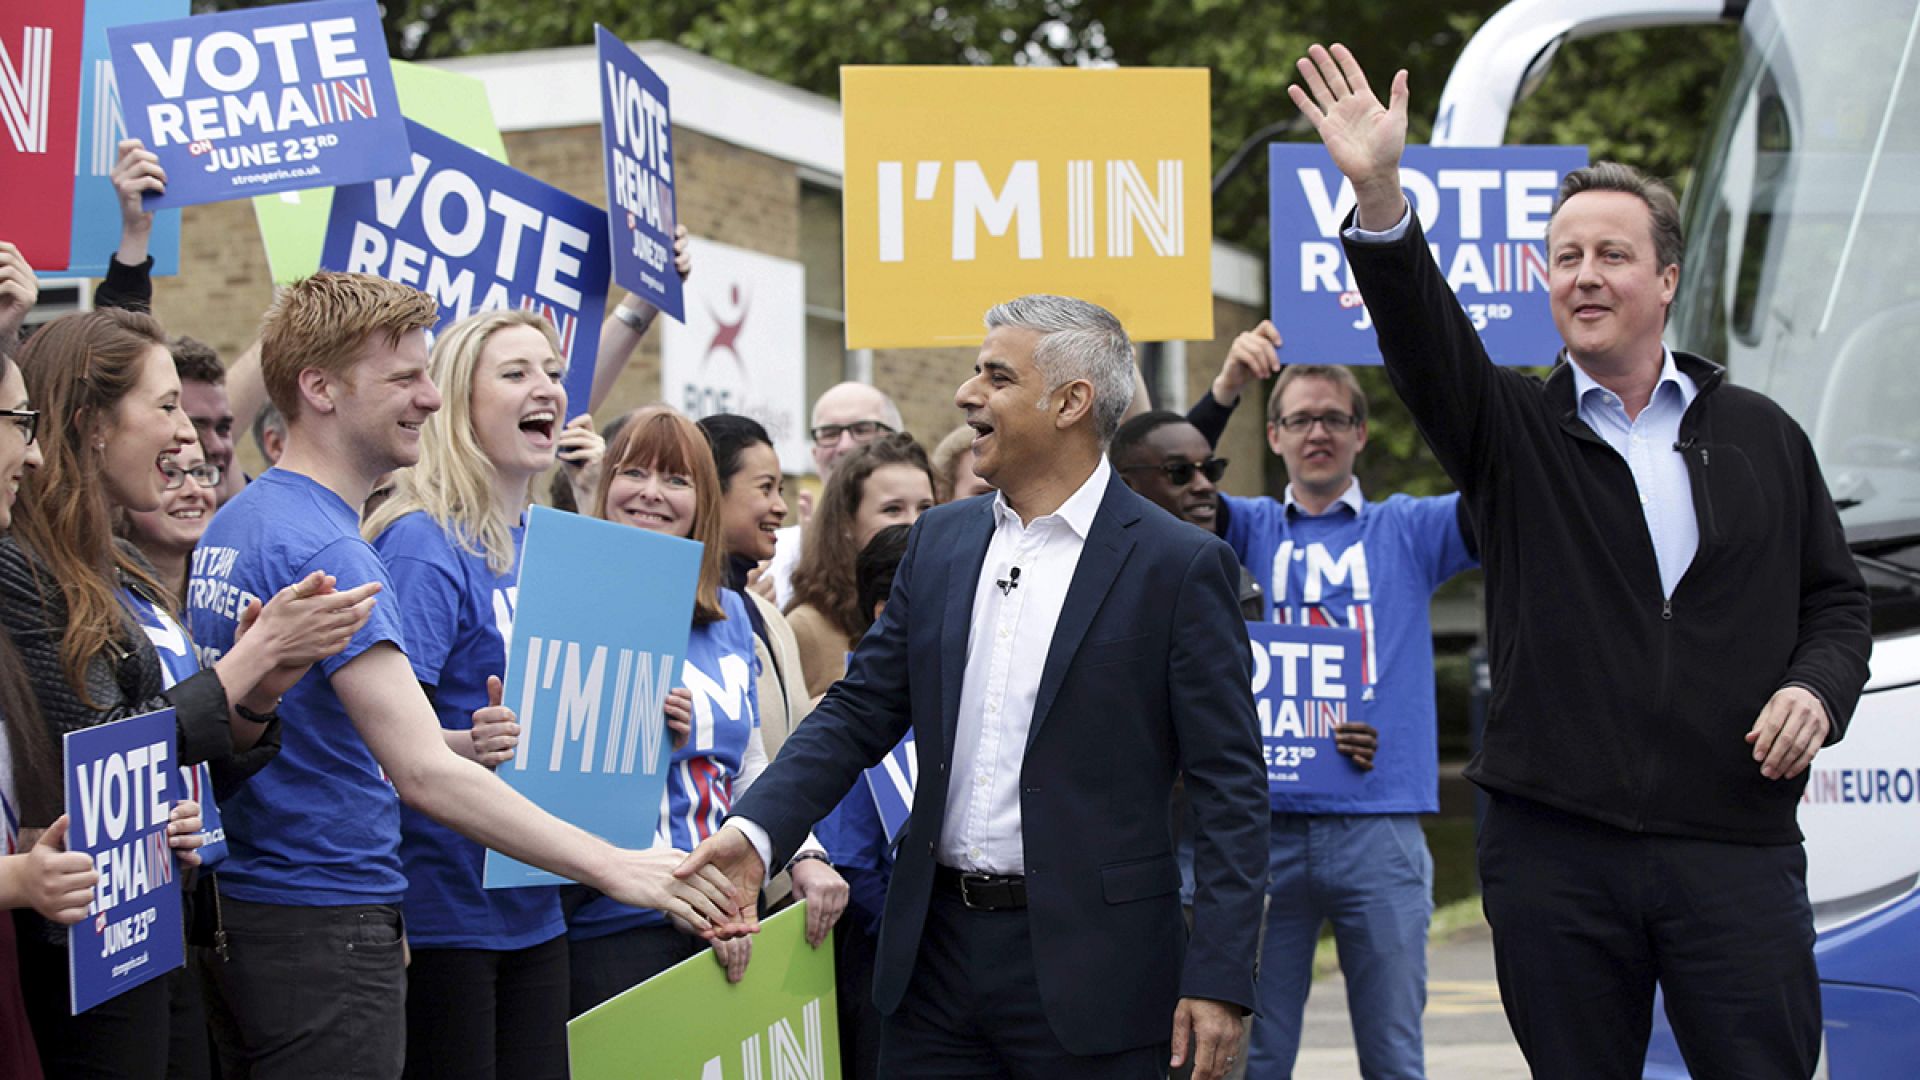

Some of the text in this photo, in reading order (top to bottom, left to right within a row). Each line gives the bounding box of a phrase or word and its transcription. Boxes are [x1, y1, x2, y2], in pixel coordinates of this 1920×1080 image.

[131, 17, 367, 98] VOTE
[147, 77, 377, 147] REMAIN
[190, 139, 214, 157] ON
[607, 61, 672, 183] VOTE
[204, 133, 338, 173] JUNE 23RD
[374, 152, 591, 312] VOTE
[877, 159, 1185, 262] I'M IN
[347, 221, 578, 370] REMN
[1301, 243, 1550, 293] RAIN
[1466, 303, 1512, 331] 3RD
[1272, 541, 1370, 602] I'M
[515, 637, 608, 773] I'M
[602, 648, 675, 775] IN
[1250, 639, 1346, 699] TE
[77, 741, 170, 848] VOTE
[87, 828, 173, 916] EMAIN
[101, 917, 134, 958] JUNE
